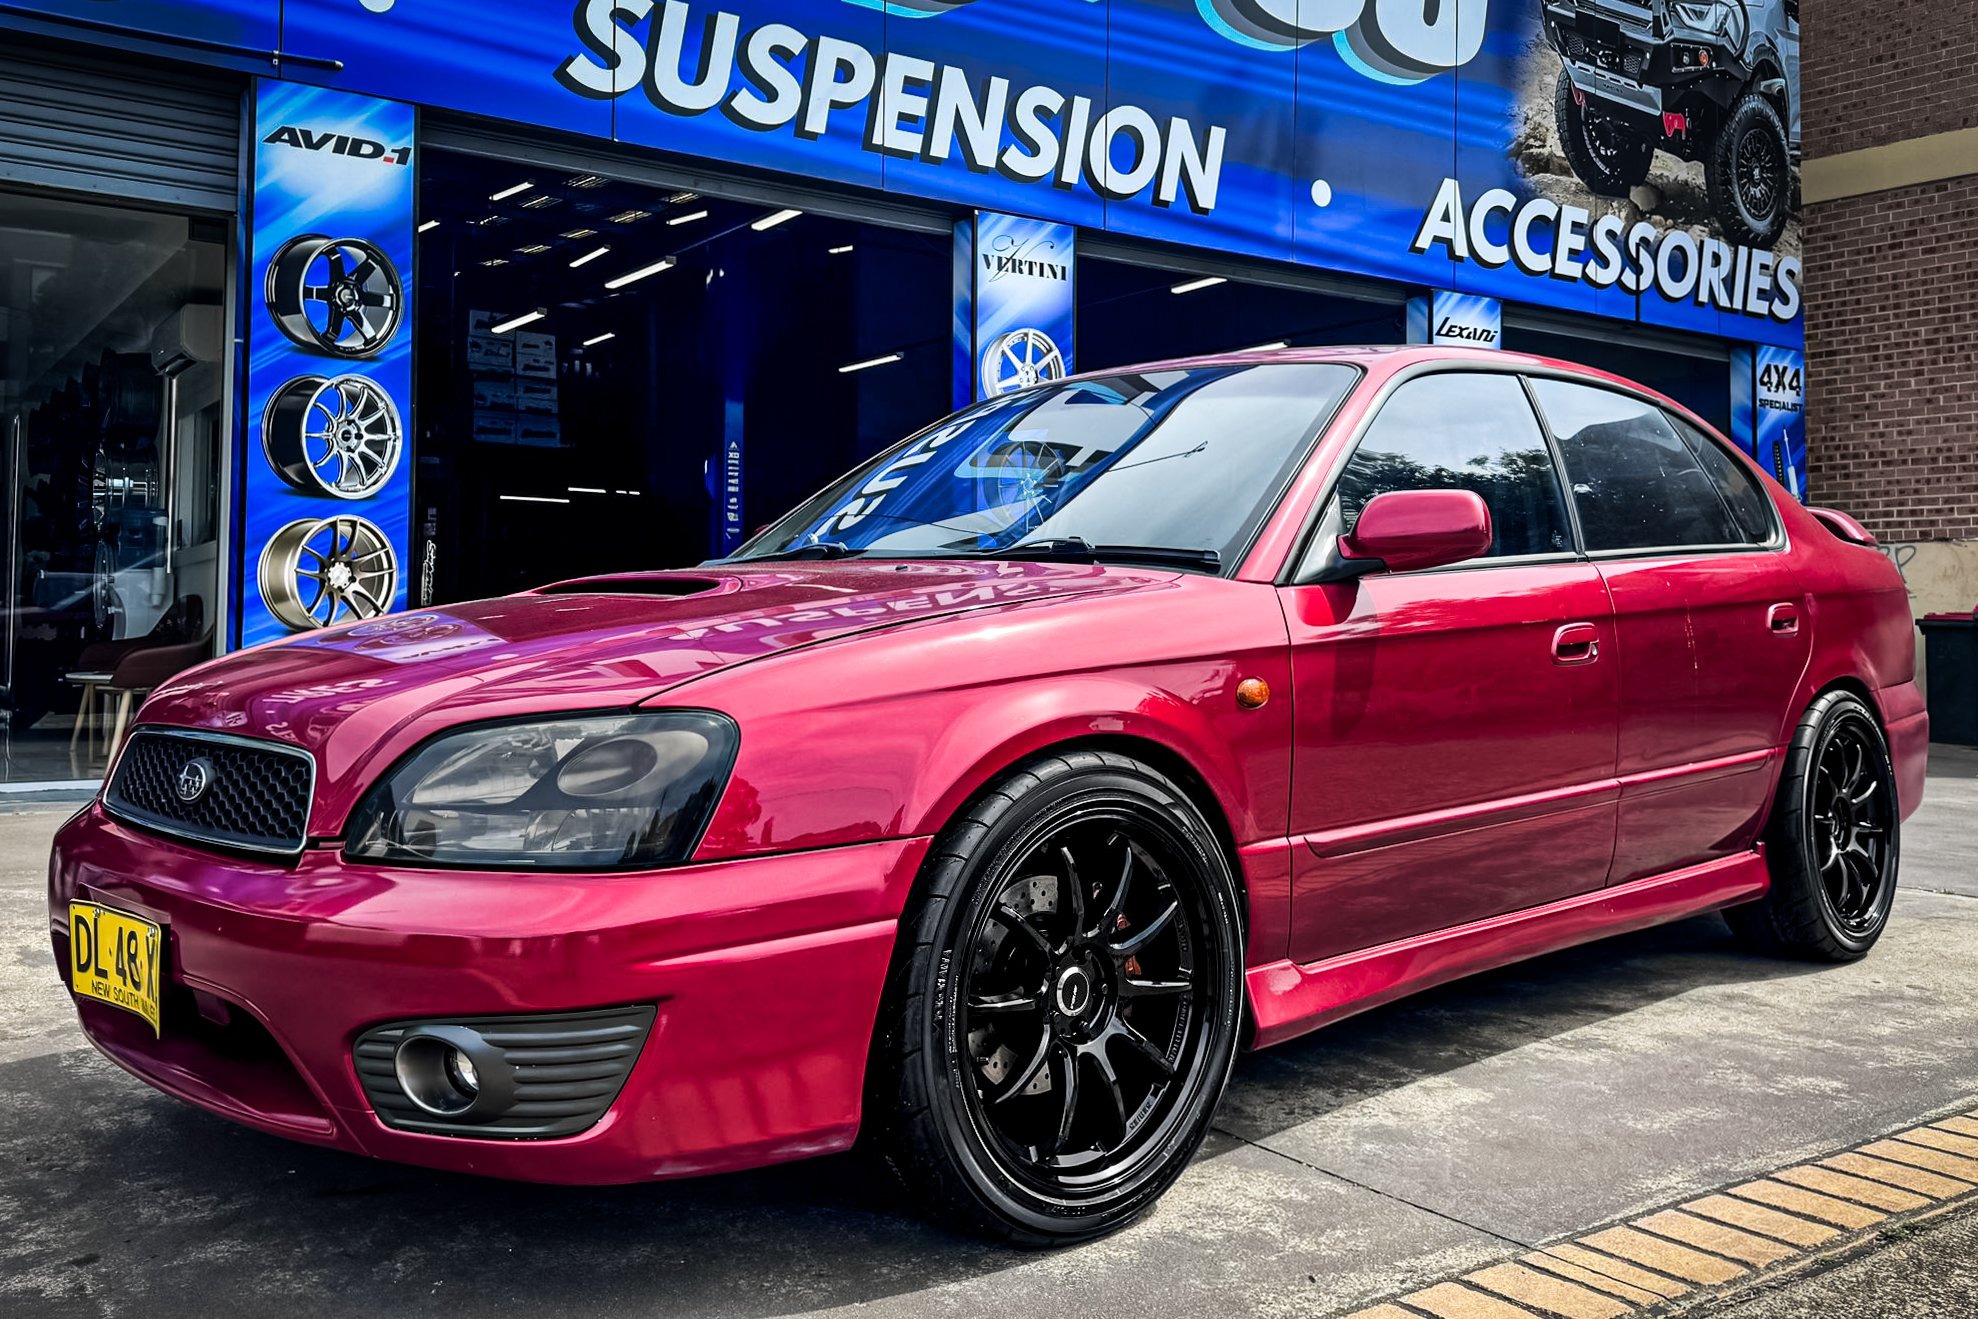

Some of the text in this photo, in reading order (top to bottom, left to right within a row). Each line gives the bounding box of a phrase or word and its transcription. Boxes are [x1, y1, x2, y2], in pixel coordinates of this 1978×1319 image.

[556, 0, 1227, 212] SUSPENSION
[263, 126, 412, 165] AVID.1
[1411, 178, 1801, 322] ACCESSORIES
[982, 253, 1067, 281] VERTINI
[1759, 364, 1802, 396] 4X4
[1759, 399, 1802, 413] SPECIALIST
[92, 979, 110, 998] NEW
[114, 986, 139, 1009] SOUTH
